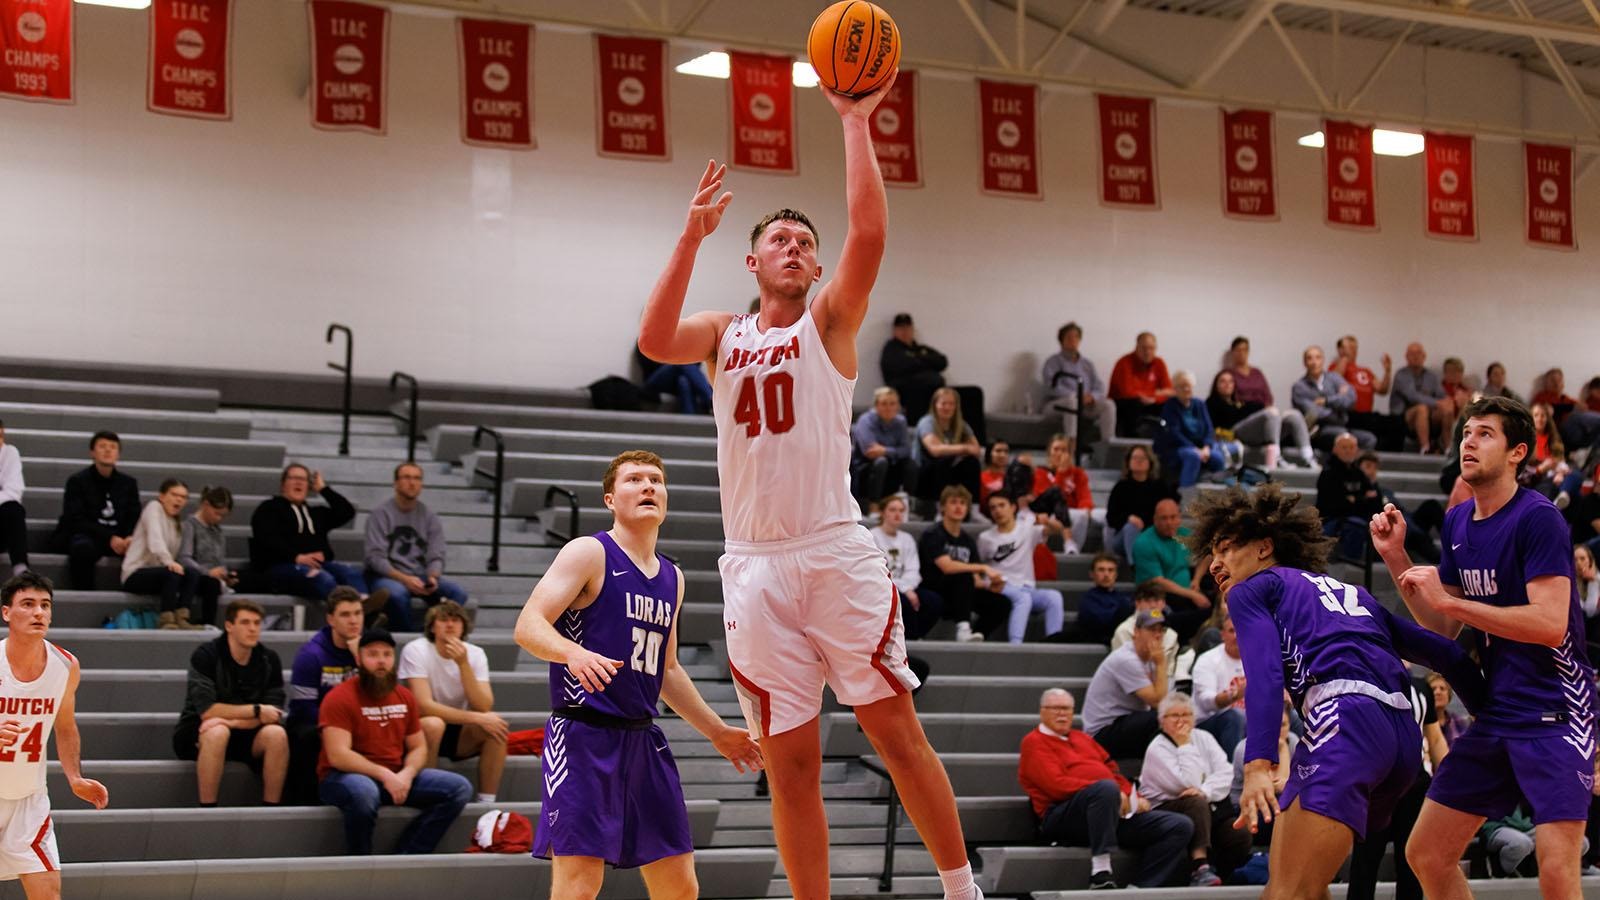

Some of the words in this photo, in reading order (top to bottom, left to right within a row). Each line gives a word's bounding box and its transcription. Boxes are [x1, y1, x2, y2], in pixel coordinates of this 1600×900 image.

[171, 2, 211, 23] IIAC
[331, 18, 368, 39] IIAC
[479, 38, 514, 58] IIAC
[844, 18, 865, 65] NCAA
[866, 19, 893, 79] Wilson
[5, 49, 60, 71] CHAMPS
[611, 52, 647, 72] IIAC
[14, 72, 47, 91] 1993
[162, 64, 217, 88] CHAMPS
[746, 67, 779, 88] IIAC
[323, 81, 373, 102] CHAMPS
[472, 98, 522, 118] CHAMPS
[992, 96, 1023, 116] IIAC
[608, 110, 657, 132] CHAMPS
[1111, 109, 1139, 129] IIAC
[740, 125, 786, 147] CHAMPS
[1232, 124, 1259, 141] IIAC
[873, 141, 911, 160] HAMPS
[988, 151, 1031, 171] CHAMPS
[1435, 147, 1461, 165] IIAC
[1108, 163, 1147, 183] CHAMPS
[1537, 157, 1561, 176] IIAC
[1230, 176, 1268, 195] CHAMPS
[1331, 185, 1367, 206] CHAMPS
[1432, 197, 1467, 216] CHAMPS
[1533, 206, 1566, 226] CHAMPS
[724, 335, 800, 371] DUTCH
[733, 371, 796, 439] 40
[1458, 568, 1498, 596] LORAS
[1301, 572, 1374, 617] 32
[625, 592, 671, 628] LORAS
[631, 626, 664, 676] 20
